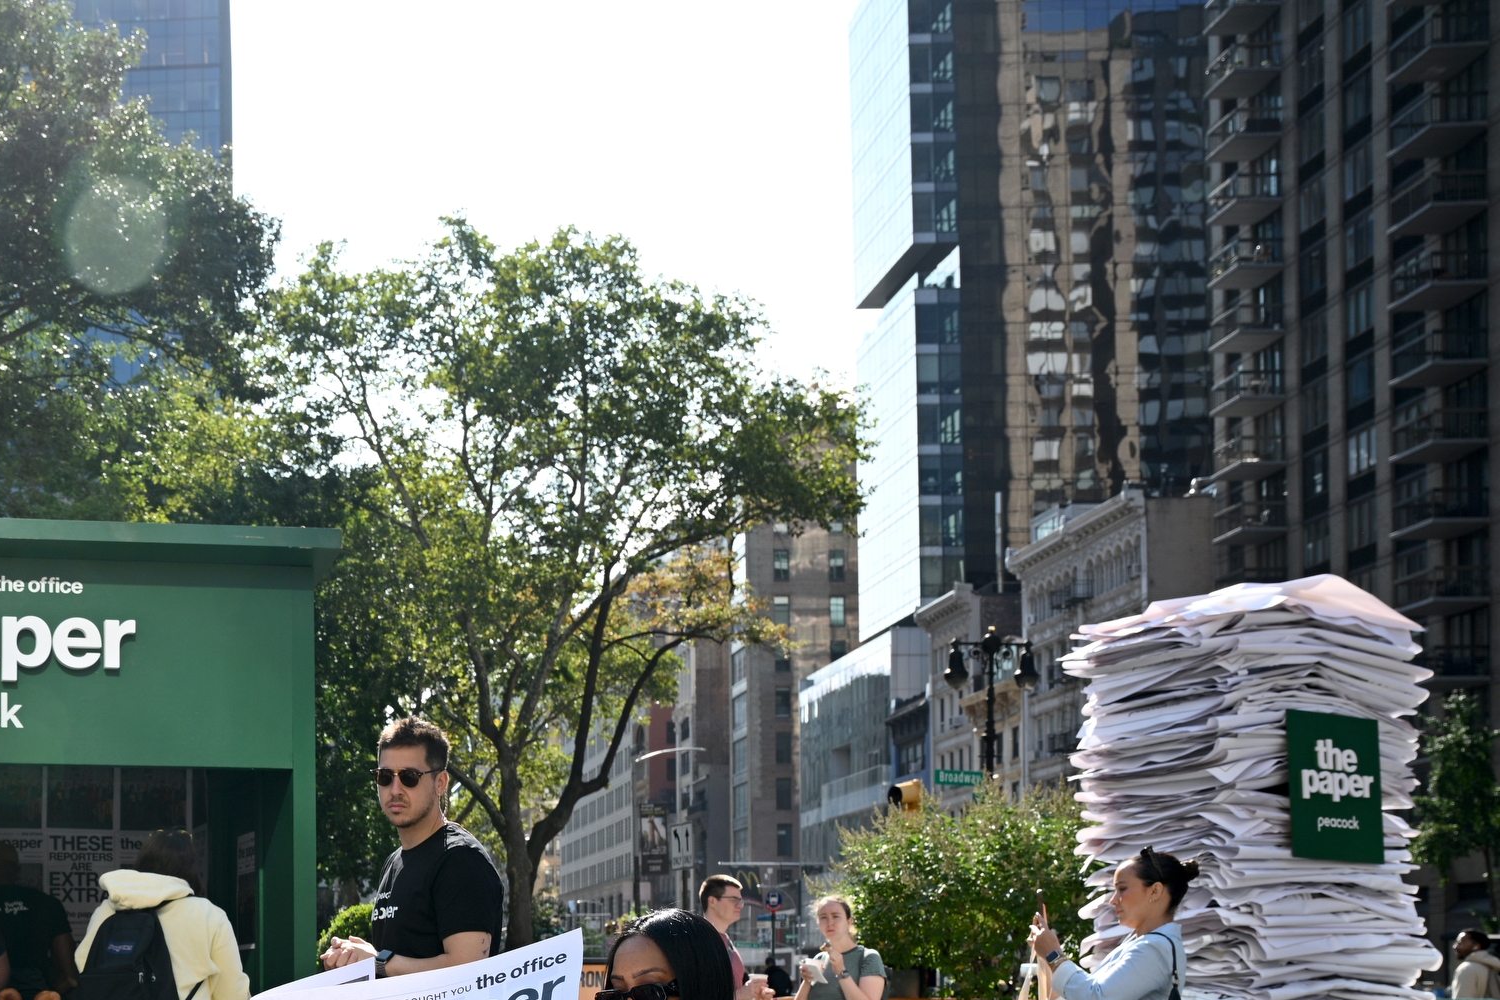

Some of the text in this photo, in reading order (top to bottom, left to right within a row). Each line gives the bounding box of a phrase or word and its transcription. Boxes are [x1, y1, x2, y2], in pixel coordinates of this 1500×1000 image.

[28, 577, 83, 594] office
[1314, 738, 1358, 773] the
[939, 771, 982, 784] Broadway
[1301, 769, 1374, 802] paper
[1317, 816, 1360, 832] peacock
[49, 836, 113, 851] THESE
[120, 838, 142, 850] the
[49, 853, 113, 861] REPORTERS
[71, 863, 92, 871] ARE
[49, 872, 100, 887] EXTR
[451, 984, 473, 996] YOU
[475, 969, 507, 990] the
[510, 951, 568, 980] office
